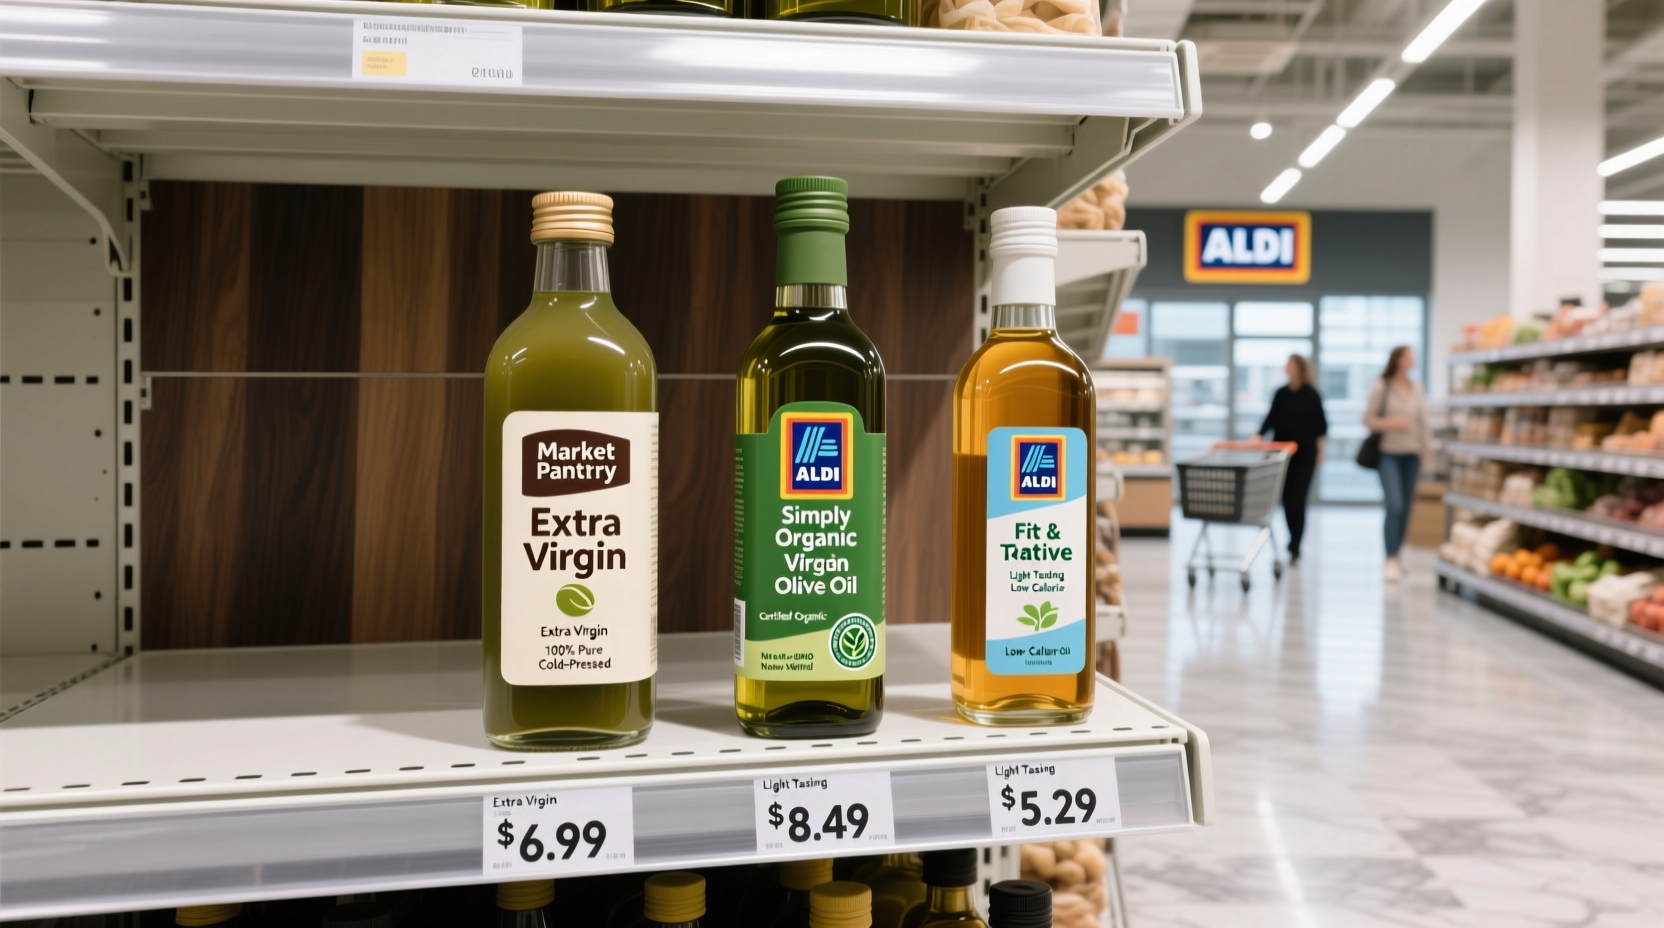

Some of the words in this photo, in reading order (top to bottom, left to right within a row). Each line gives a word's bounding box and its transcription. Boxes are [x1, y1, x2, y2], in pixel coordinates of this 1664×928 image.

[1201, 227, 1295, 265] ALDI
[537, 441, 616, 461] Market
[795, 466, 840, 482] ALDI
[1021, 475, 1056, 488] ALDI
[531, 507, 621, 537] Extra
[781, 505, 852, 531] Simply
[775, 528, 858, 552] Organic
[1015, 522, 1041, 540] Fit
[1046, 522, 1061, 540] &
[523, 541, 627, 580] Virgin
[774, 576, 826, 596] Olive
[830, 576, 858, 595] Oil
[1011, 583, 1029, 593] Low
[541, 625, 572, 637] Extra
[545, 644, 575, 656] 100%
[578, 644, 603, 656] Pure
[538, 657, 611, 670] Cold-Pressed
[1001, 783, 1097, 827] $5.29
[768, 801, 869, 843] $8.49
[497, 818, 607, 862] $6.99
